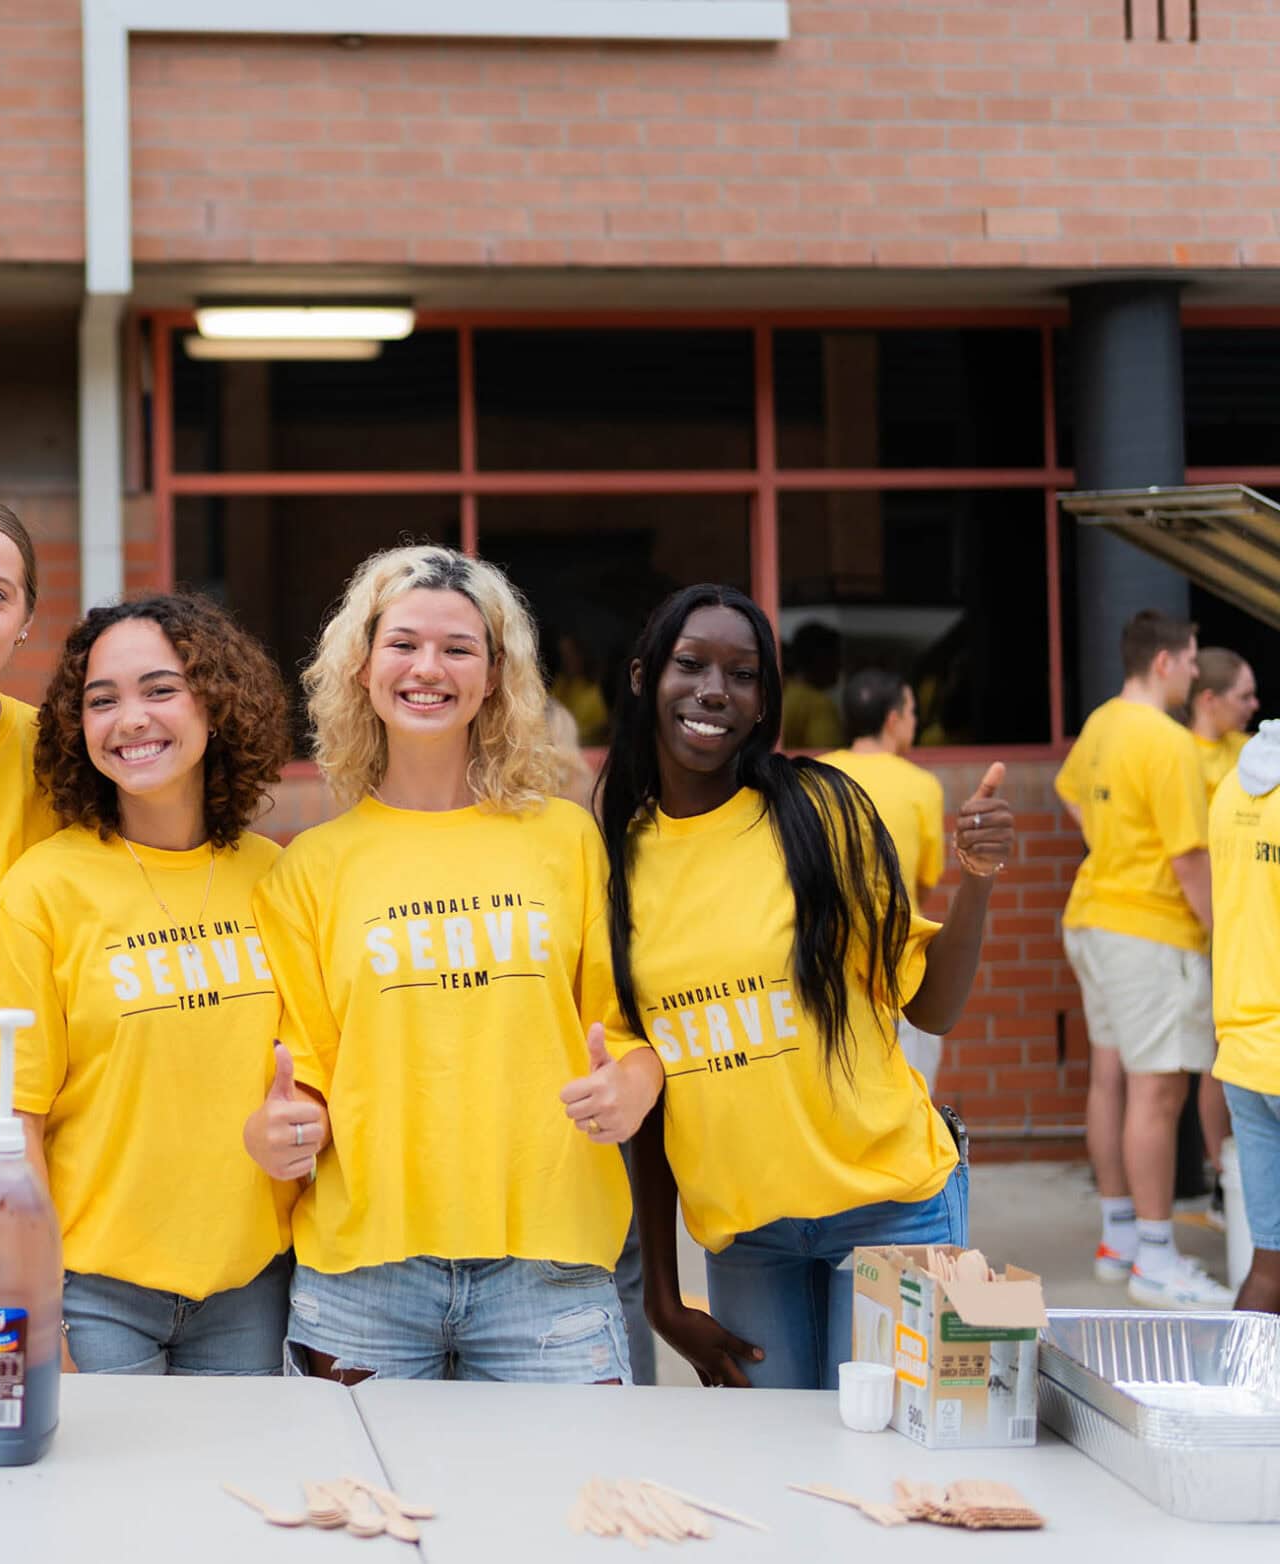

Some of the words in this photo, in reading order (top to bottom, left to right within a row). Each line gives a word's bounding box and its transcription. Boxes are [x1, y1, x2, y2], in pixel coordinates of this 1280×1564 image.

[388, 896, 480, 920] AVONDALE
[491, 893, 523, 908] UNI
[127, 924, 207, 949] AVONDALE
[214, 920, 241, 935] UNI
[366, 910, 551, 976] SERVE
[109, 936, 273, 1001] SERVE
[440, 970, 489, 989] TEAM
[179, 991, 220, 1010] TEAM
[661, 981, 730, 1011] AVONDALE
[736, 975, 765, 993] UNI
[652, 990, 798, 1063] SERVE
[707, 1052, 748, 1073] TEAM
